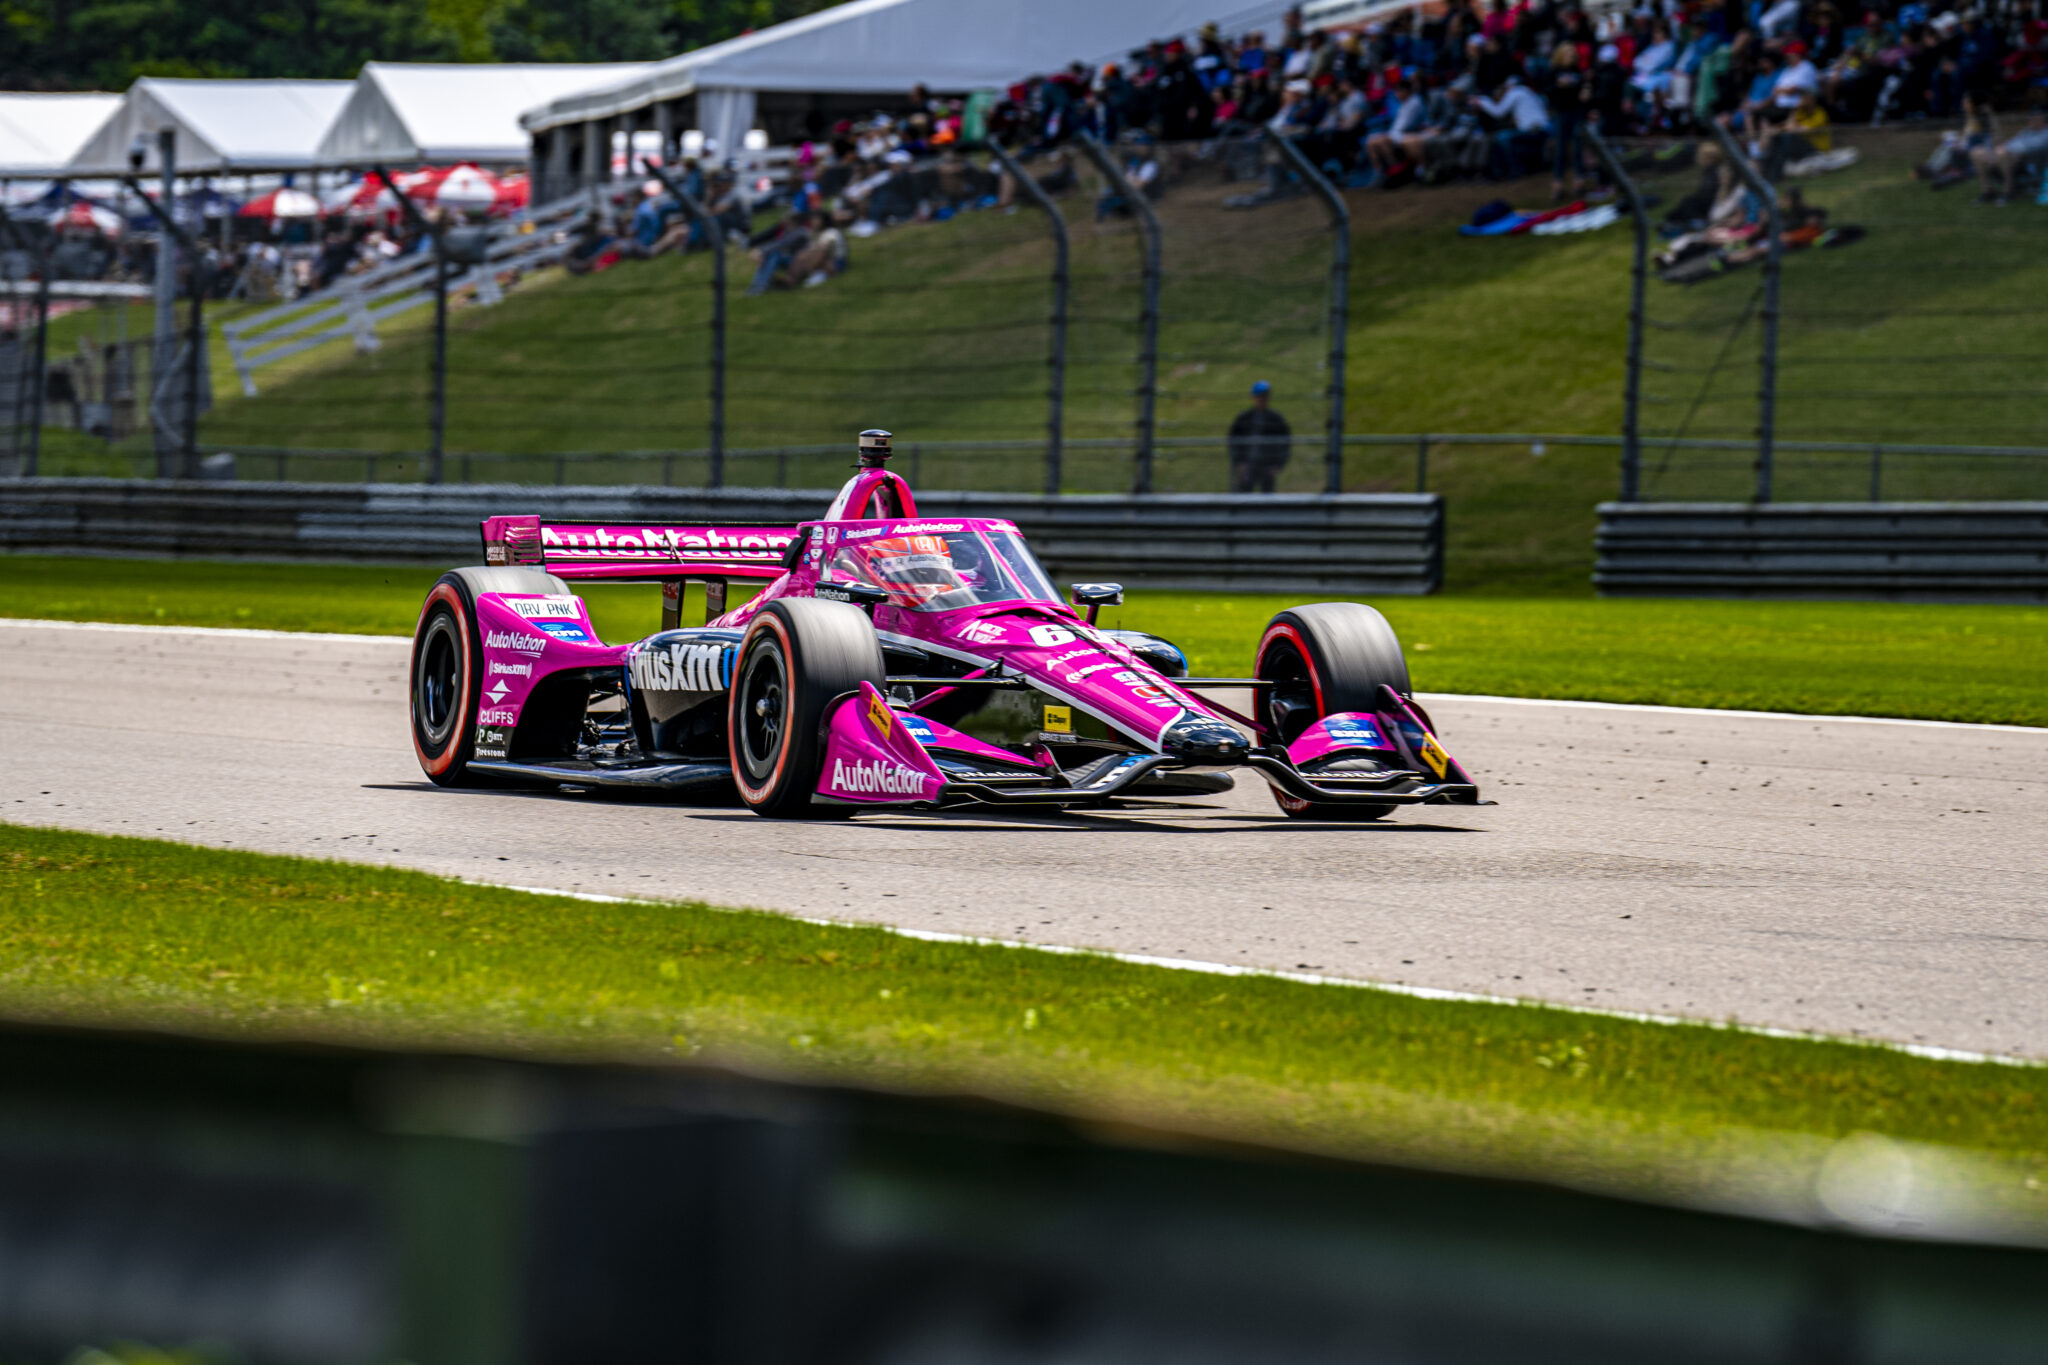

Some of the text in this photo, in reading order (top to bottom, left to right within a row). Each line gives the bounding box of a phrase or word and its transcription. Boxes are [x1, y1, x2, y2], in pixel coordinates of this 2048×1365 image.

[892, 523, 964, 534] AutoNation
[541, 527, 792, 559] AutoNation
[549, 604, 573, 616] PNK
[485, 630, 547, 652] AutoNation
[480, 710, 514, 725] CLIFFS
[476, 748, 506, 758] Firestone
[831, 758, 927, 794] AutoNation
